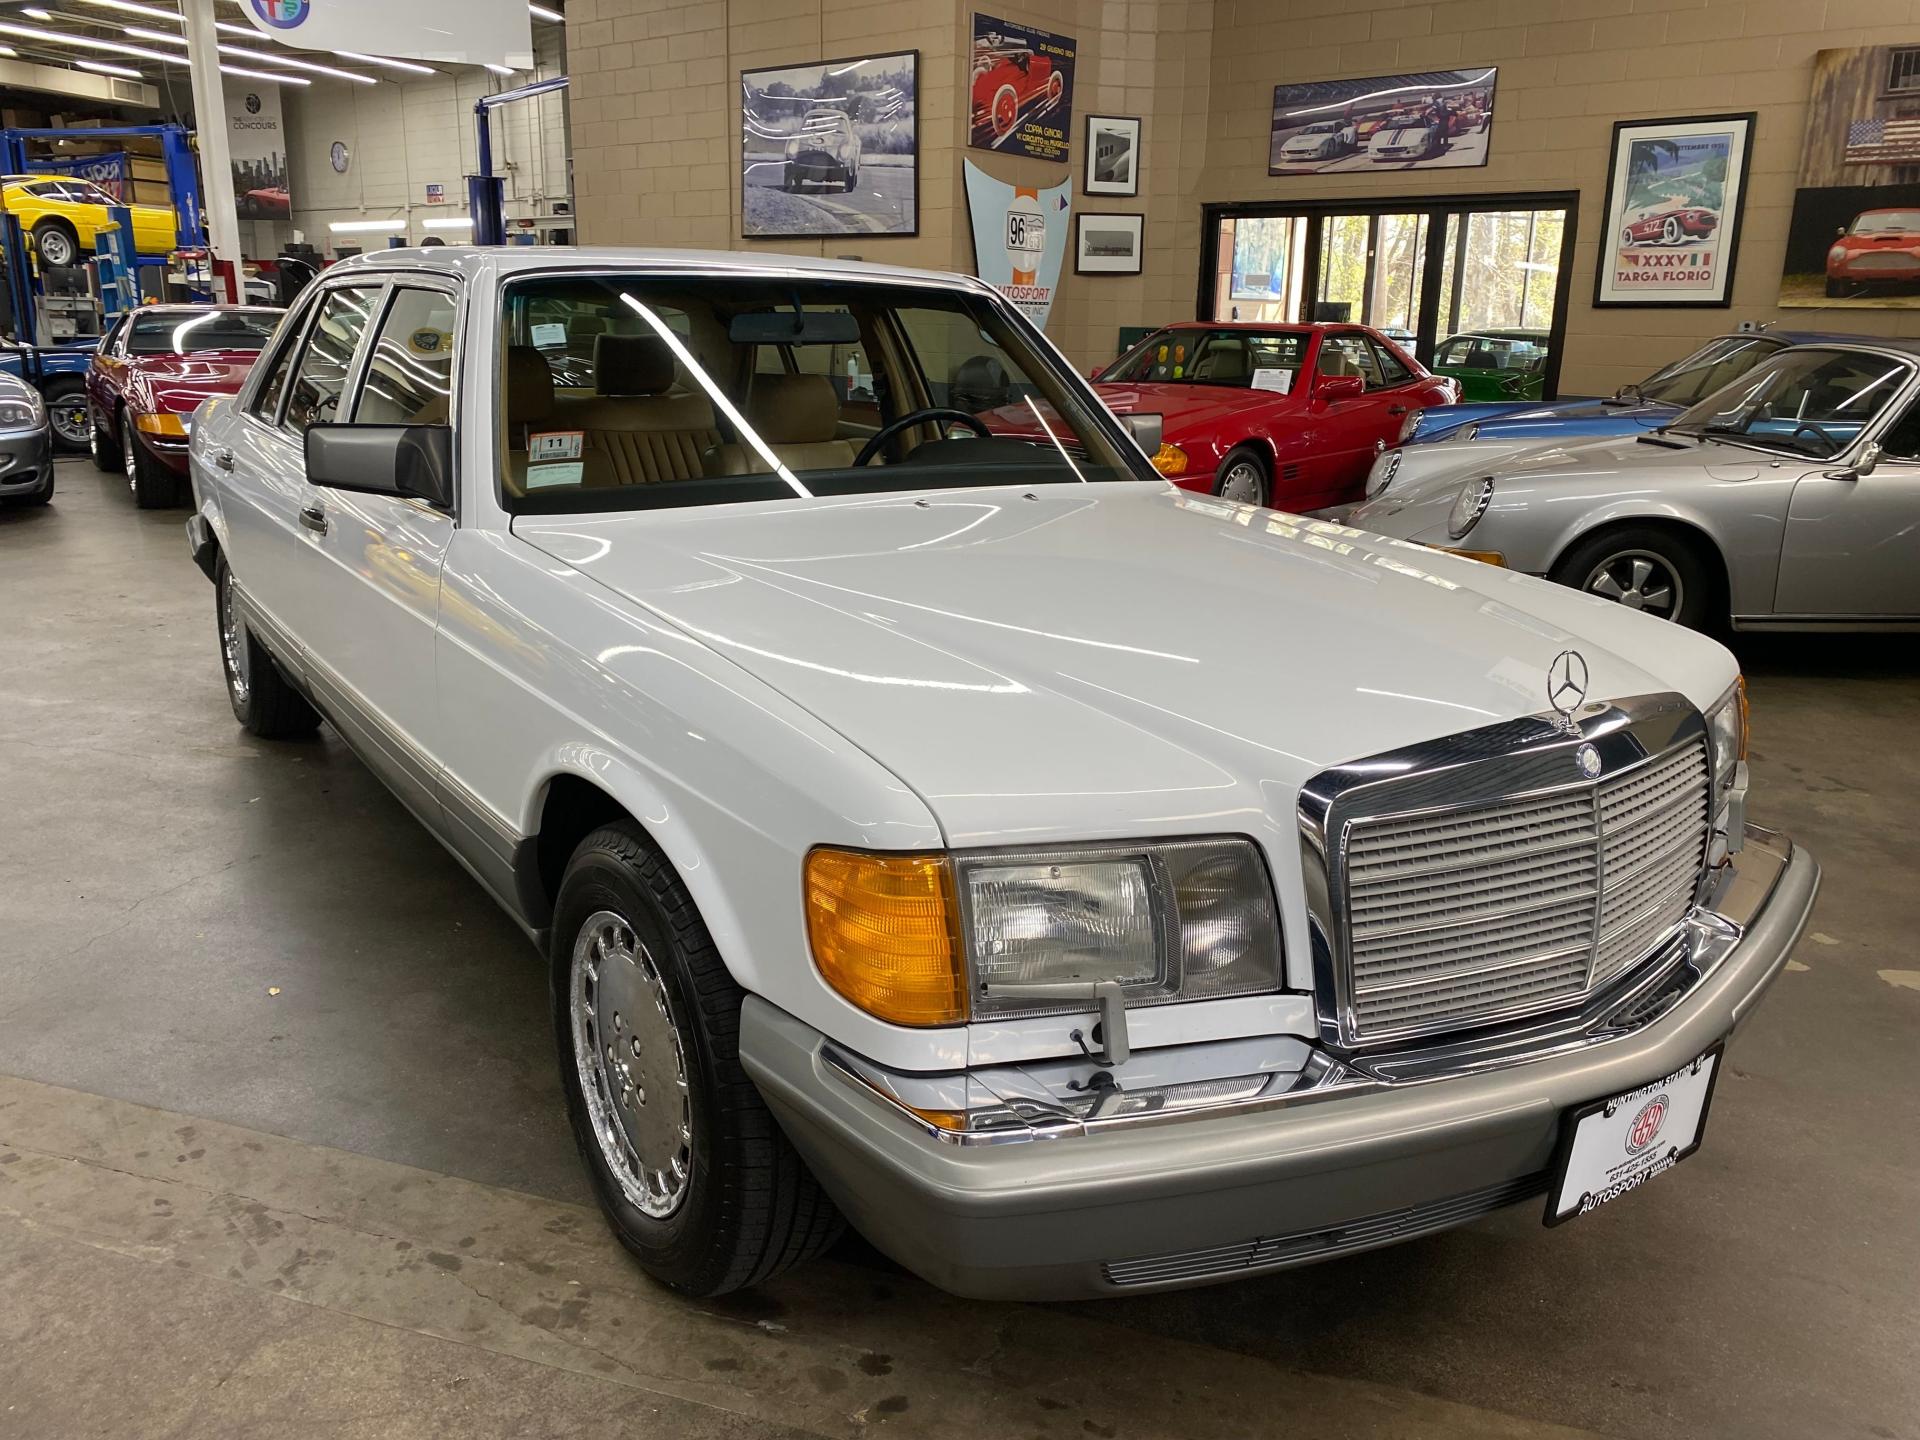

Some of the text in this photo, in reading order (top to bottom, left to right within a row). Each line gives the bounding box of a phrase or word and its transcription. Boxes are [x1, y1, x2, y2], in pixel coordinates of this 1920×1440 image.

[233, 122, 277, 130] CONCOURS
[1024, 123, 1063, 139] COPPA GINORI
[1022, 134, 1044, 145] CIRCUITO
[1050, 139, 1070, 149] MUGELLO
[1010, 217, 1025, 246] 96
[1642, 254, 1688, 267] XXXV
[1617, 270, 1711, 282] TARGA FLORIO
[994, 285, 1051, 300] UTOSPORT
[1032, 307, 1044, 315] INC
[547, 438, 563, 448] 11
[1606, 1079, 1665, 1111] HUNTINGTON
[1665, 1061, 1695, 1085] STATION
[1578, 1169, 1650, 1216] AUTOSPORT
